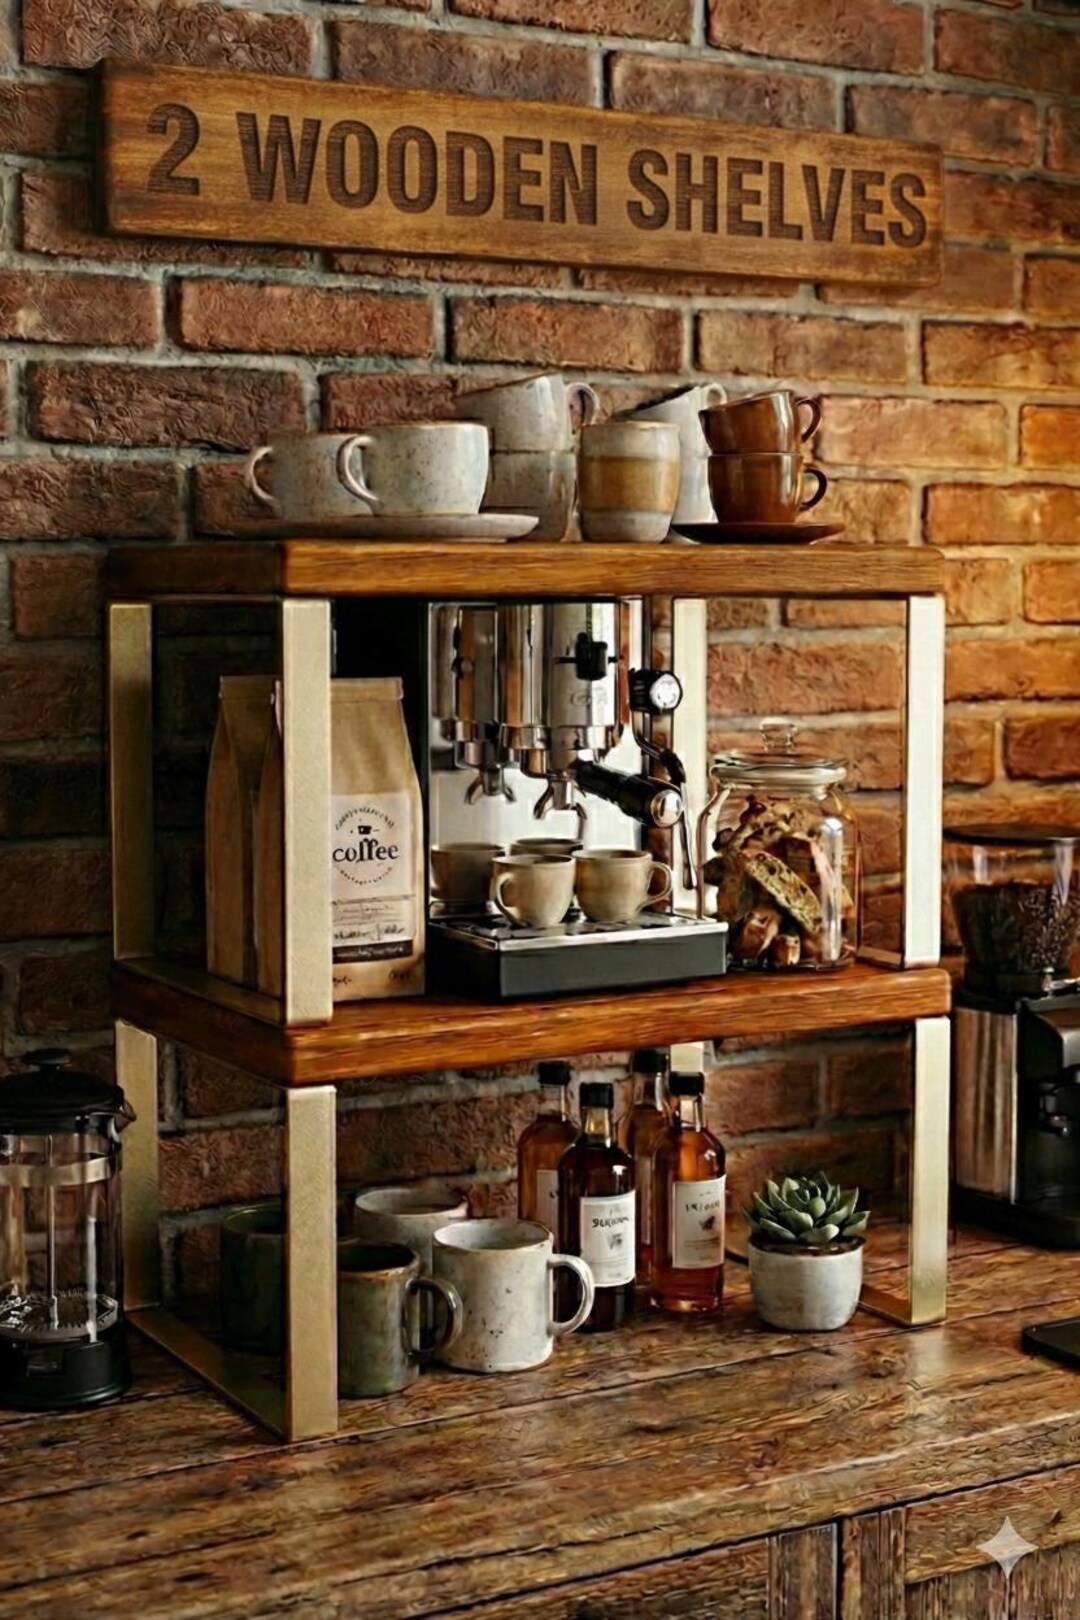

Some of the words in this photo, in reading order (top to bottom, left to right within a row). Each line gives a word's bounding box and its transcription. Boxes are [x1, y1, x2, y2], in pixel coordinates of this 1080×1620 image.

[147, 104, 200, 195] 2
[236, 111, 598, 225] WOODEN
[627, 149, 927, 248] SHELVES
[332, 838, 399, 862] coffee
